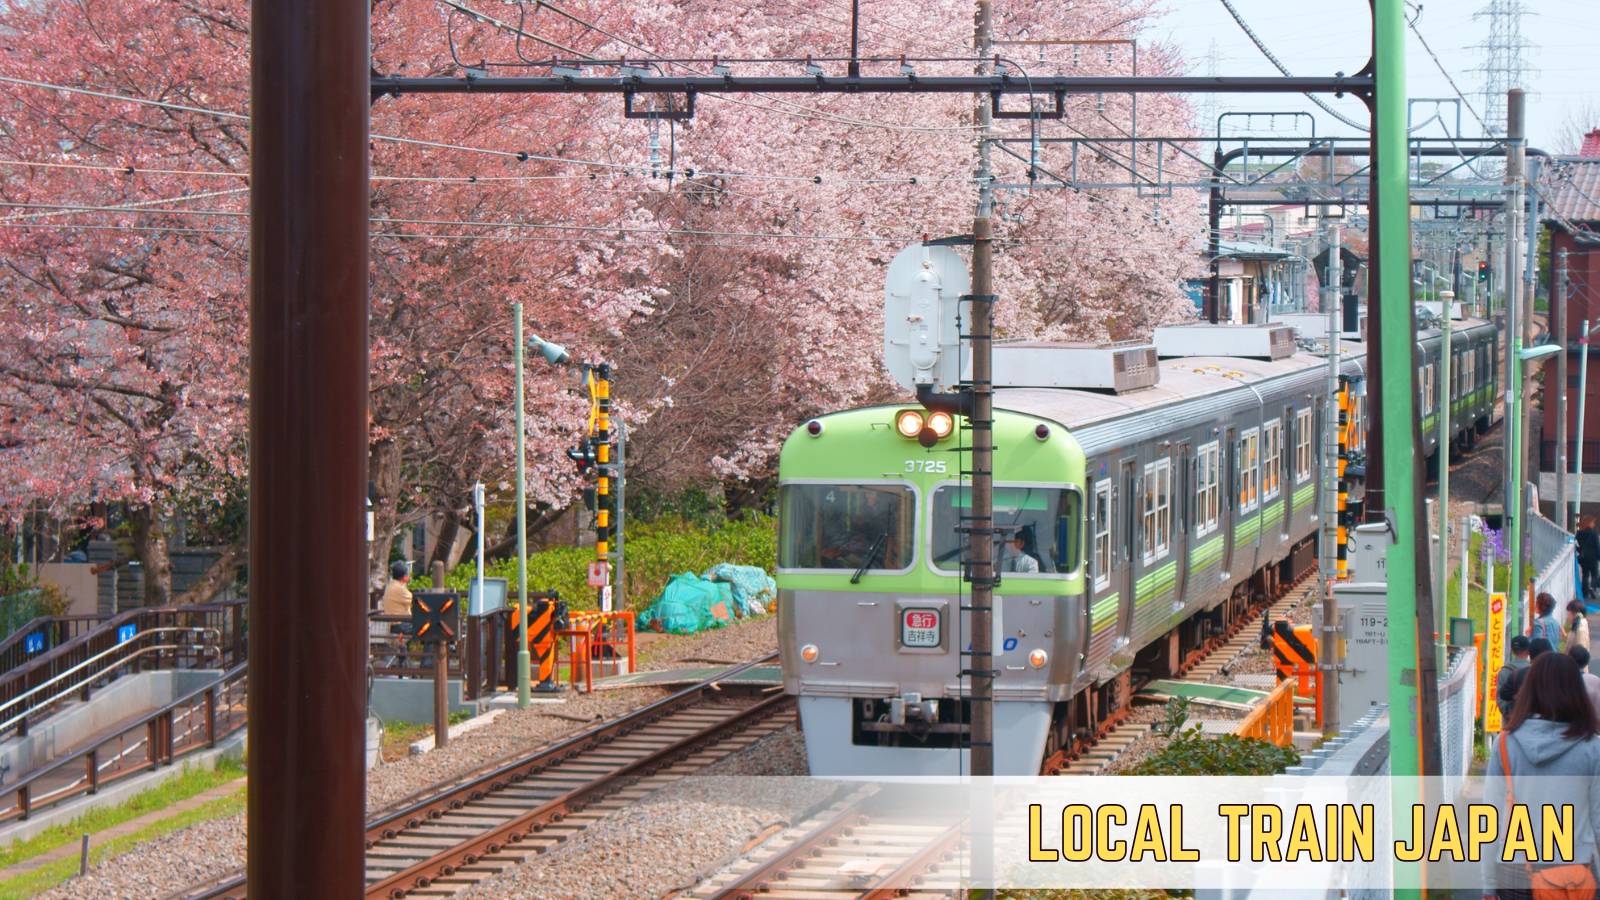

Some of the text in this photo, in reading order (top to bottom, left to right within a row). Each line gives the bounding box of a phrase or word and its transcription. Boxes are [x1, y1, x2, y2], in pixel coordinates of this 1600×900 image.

[905, 460, 946, 473] 3725
[826, 490, 835, 503] 4
[912, 614, 932, 628] 急行
[908, 630, 935, 642] 吉祥寺
